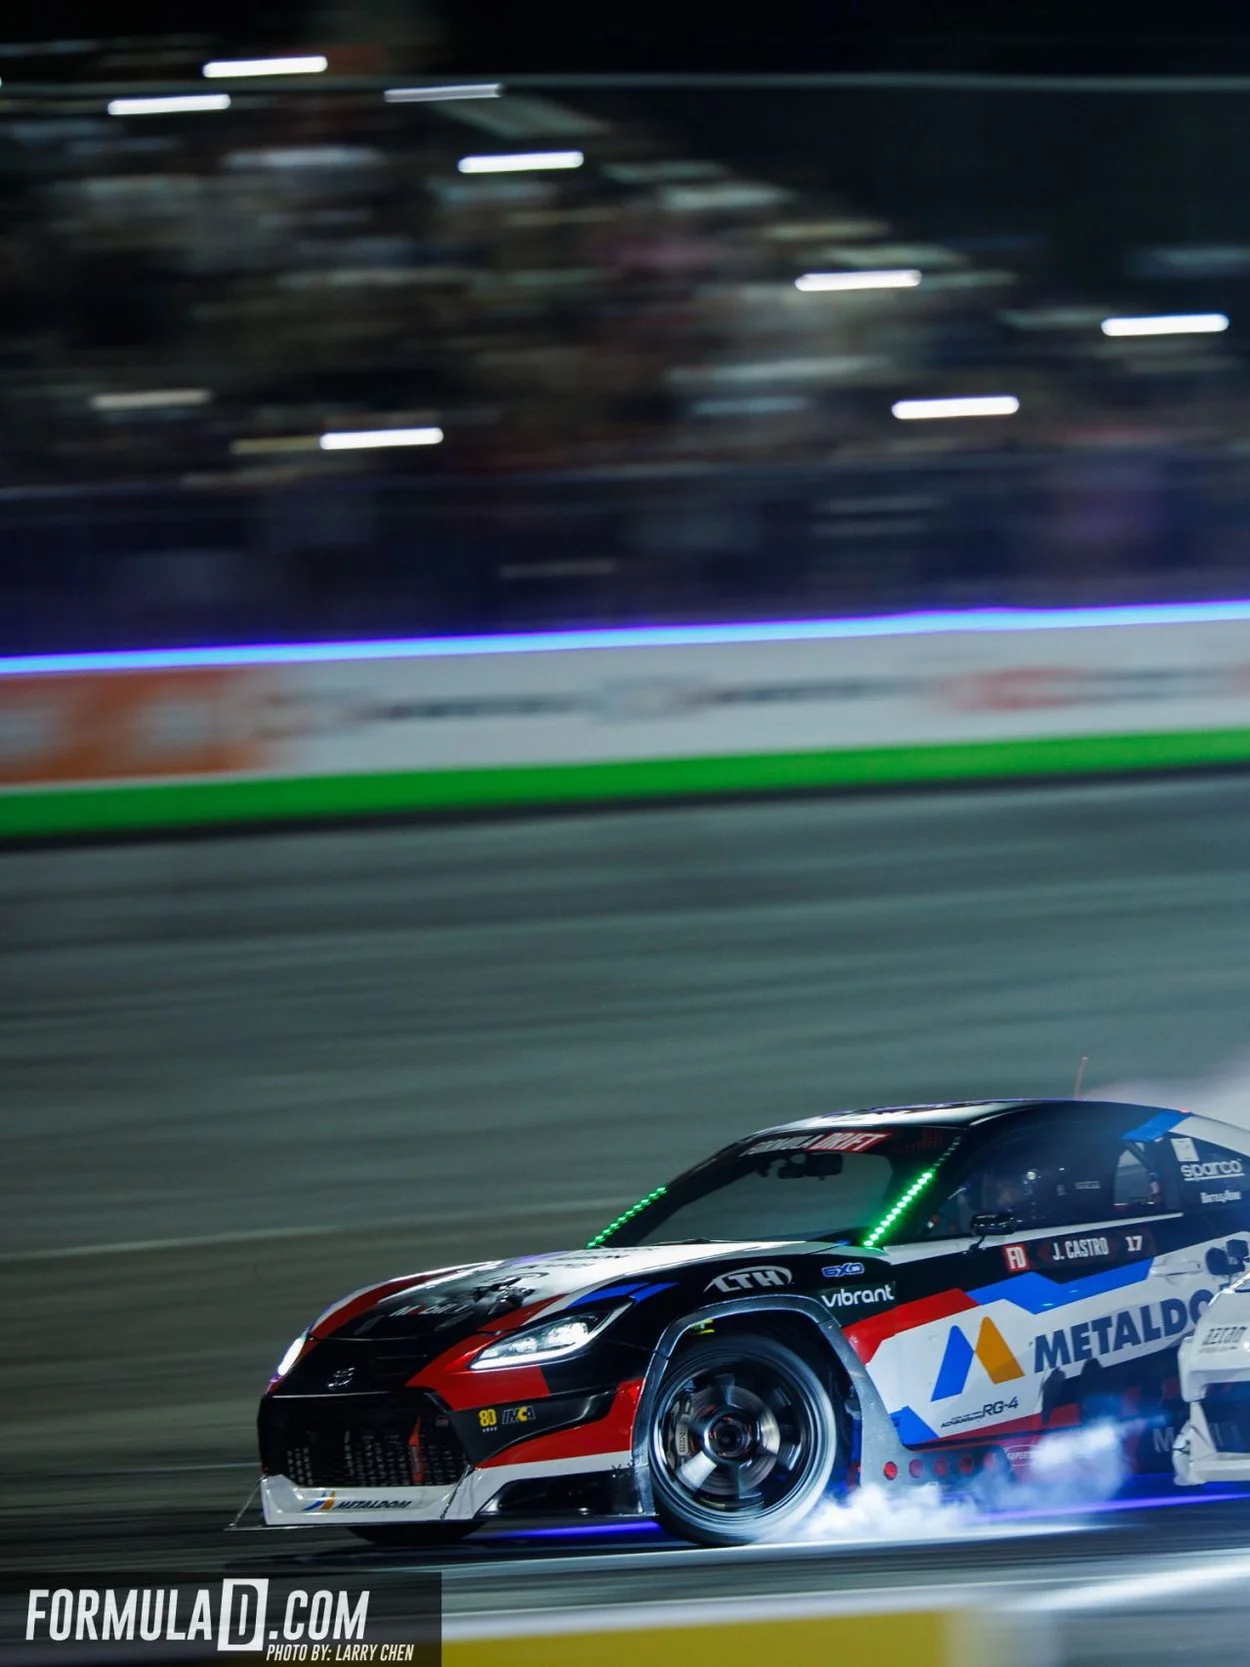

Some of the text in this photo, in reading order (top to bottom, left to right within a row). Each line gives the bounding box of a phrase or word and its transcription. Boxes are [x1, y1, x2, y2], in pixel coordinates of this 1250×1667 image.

[808, 1133, 889, 1151] DRIFT
[1181, 1157, 1244, 1180] sparco
[1053, 1237, 1109, 1260] J. CASTRO
[1125, 1235, 1143, 1251] 17
[713, 1270, 783, 1292] LTH
[1034, 1289, 1214, 1373] METALDO
[982, 1397, 1019, 1416] RG-4
